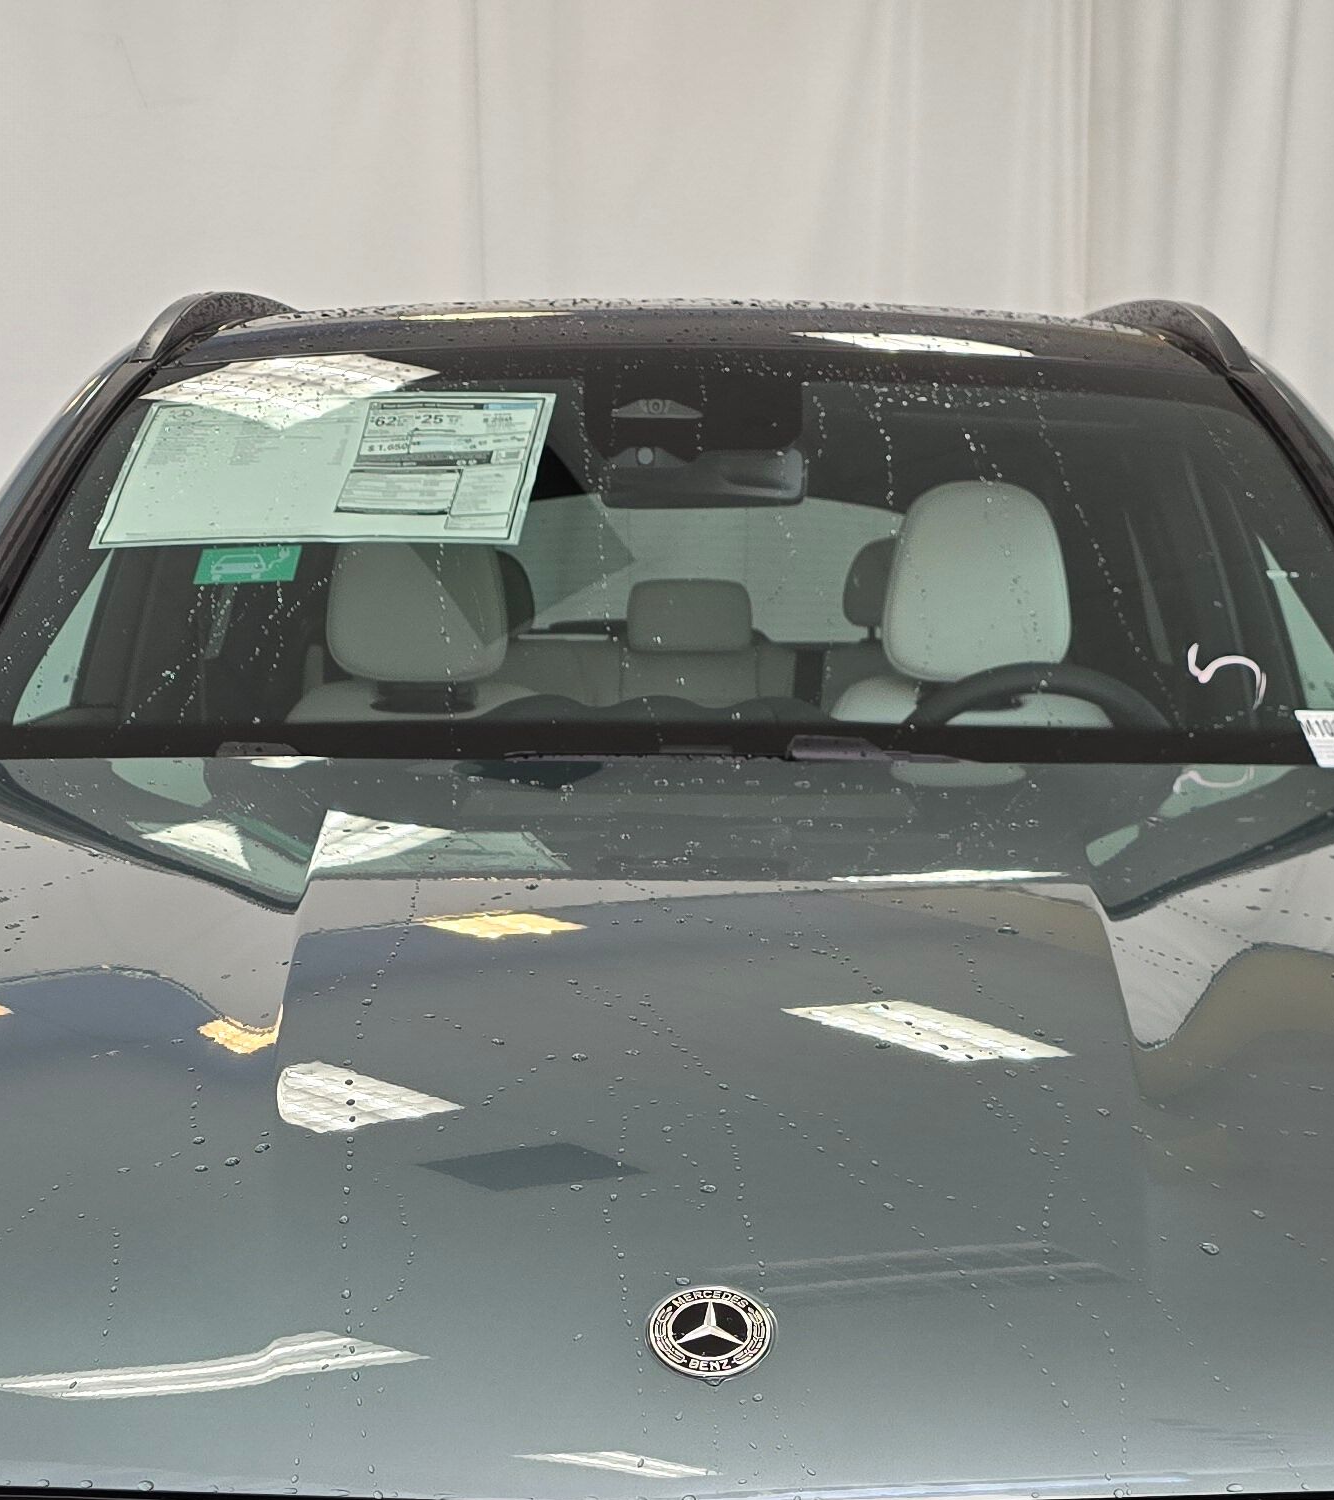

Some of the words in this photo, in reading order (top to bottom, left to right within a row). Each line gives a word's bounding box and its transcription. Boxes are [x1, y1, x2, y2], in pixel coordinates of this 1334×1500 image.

[421, 414, 444, 424] 25
[672, 1289, 749, 1308] MERCEDES
[688, 1358, 732, 1371] BENZ
